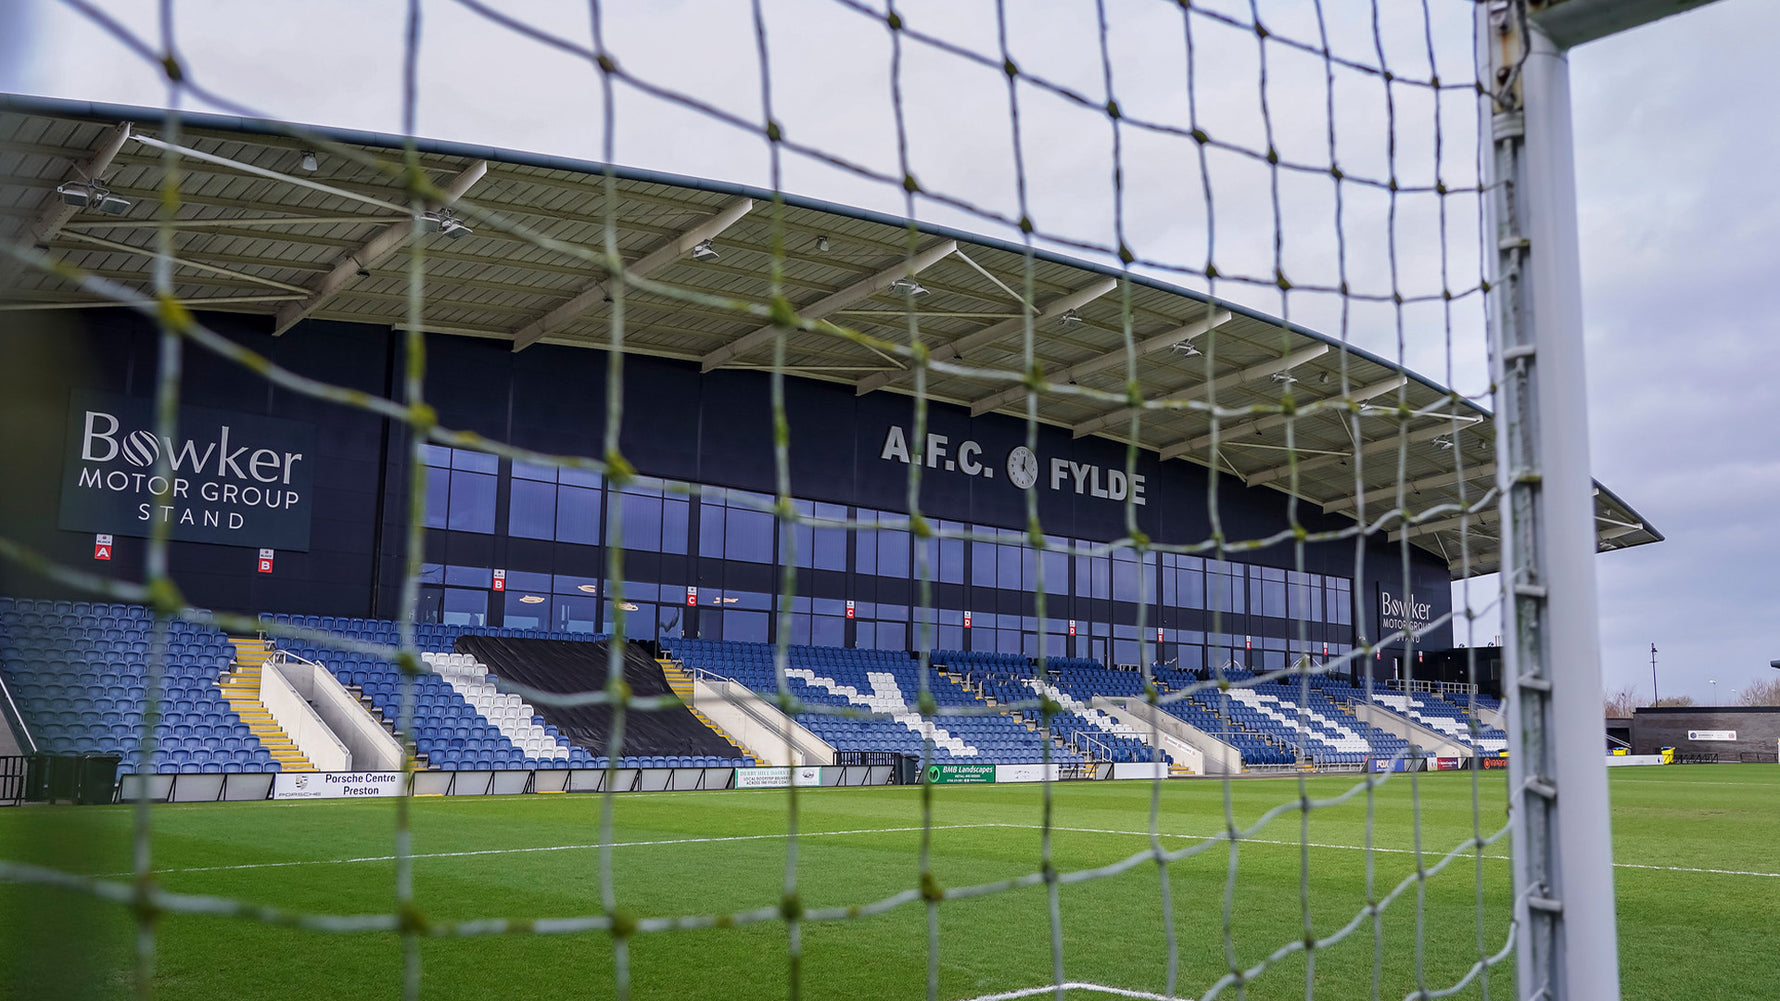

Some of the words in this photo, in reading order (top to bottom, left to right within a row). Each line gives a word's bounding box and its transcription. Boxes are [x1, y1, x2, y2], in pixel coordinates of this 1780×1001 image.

[81, 410, 302, 485] Bowker
[880, 425, 994, 478] A.F.C.
[1050, 457, 1146, 505] FYLDE
[78, 467, 190, 498] MOTOR
[200, 481, 299, 510] GROUP
[138, 503, 244, 529] STAND
[96, 546, 110, 558] A
[261, 560, 271, 571] B
[494, 580, 503, 589] B
[688, 596, 697, 604] C
[1382, 591, 1431, 620] Bowker
[942, 766, 957, 774] BMB
[958, 765, 993, 775] Landscapes
[1376, 760, 1390, 769] FOX
[325, 774, 364, 784] Porsche
[365, 774, 396, 783] Centre
[343, 786, 379, 795] Preston
